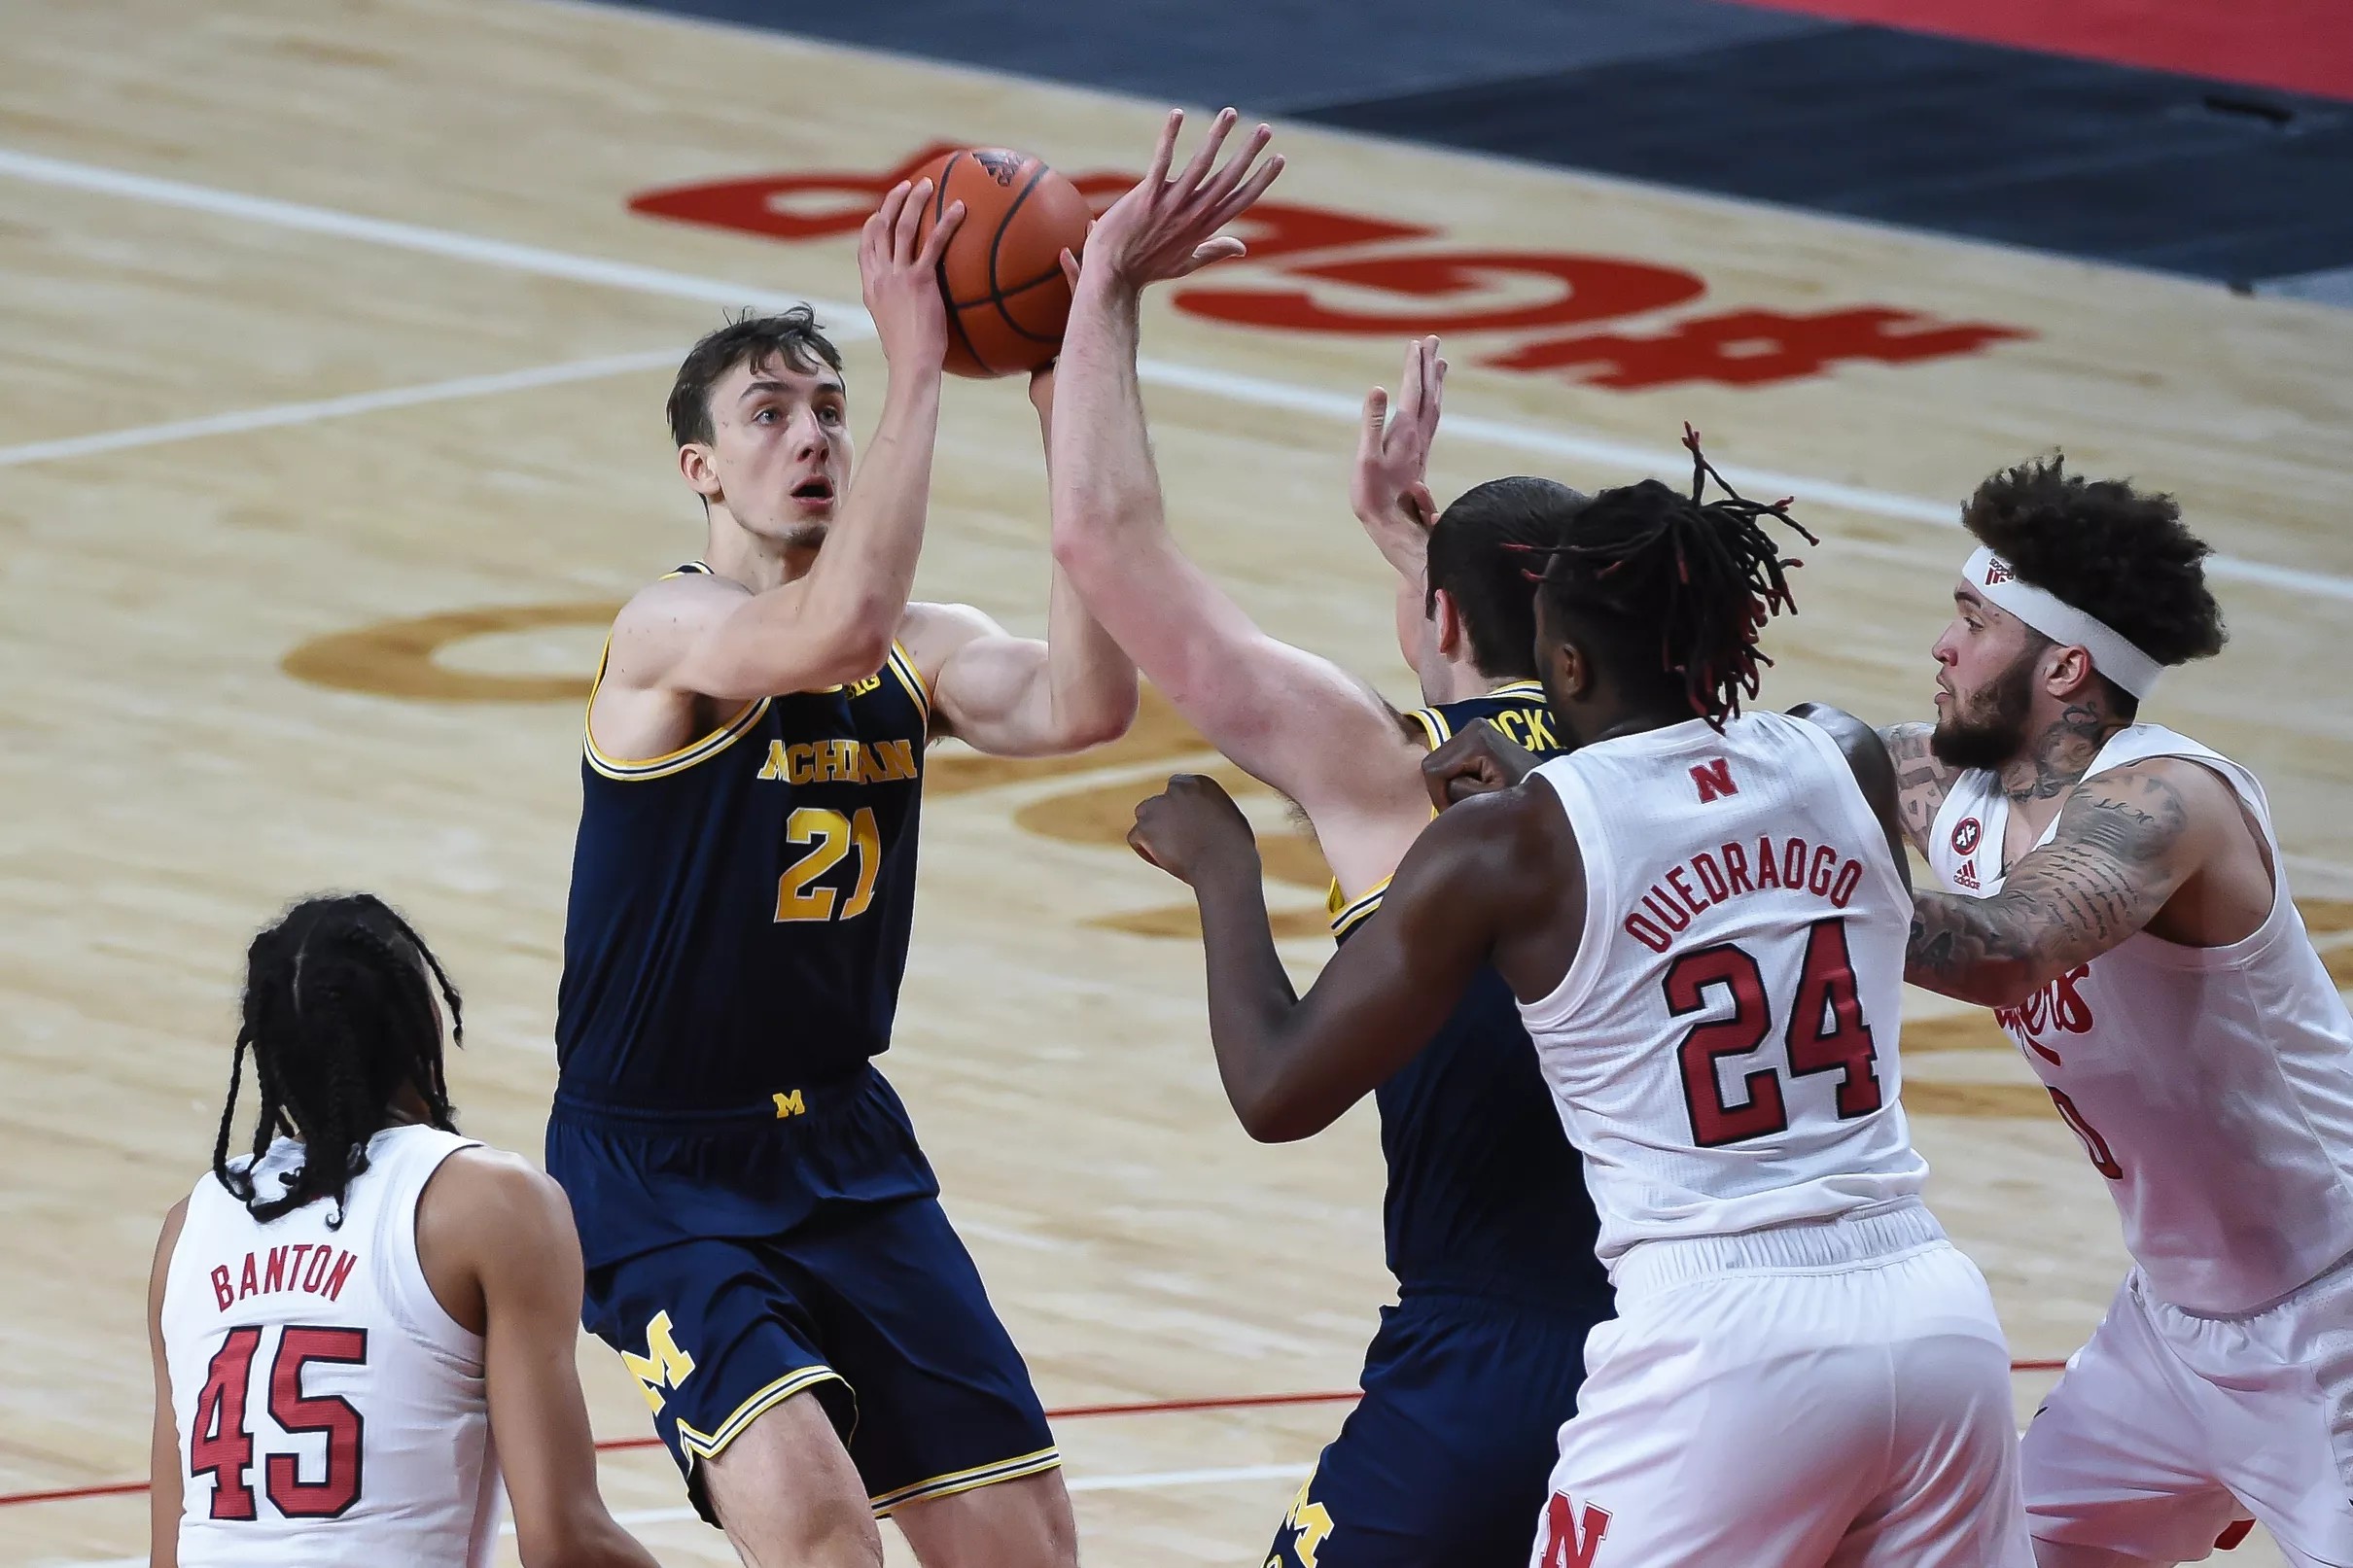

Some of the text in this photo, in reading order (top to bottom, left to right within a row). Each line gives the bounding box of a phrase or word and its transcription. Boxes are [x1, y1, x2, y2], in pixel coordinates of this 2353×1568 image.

[1690, 757, 1739, 804] N
[774, 807, 881, 923] 21
[1625, 836, 1863, 954] OUEDRAOGO
[1662, 916, 1882, 1148] 24
[773, 1090, 805, 1118] M
[211, 1244, 358, 1313] BANTON
[191, 1324, 369, 1521] 45
